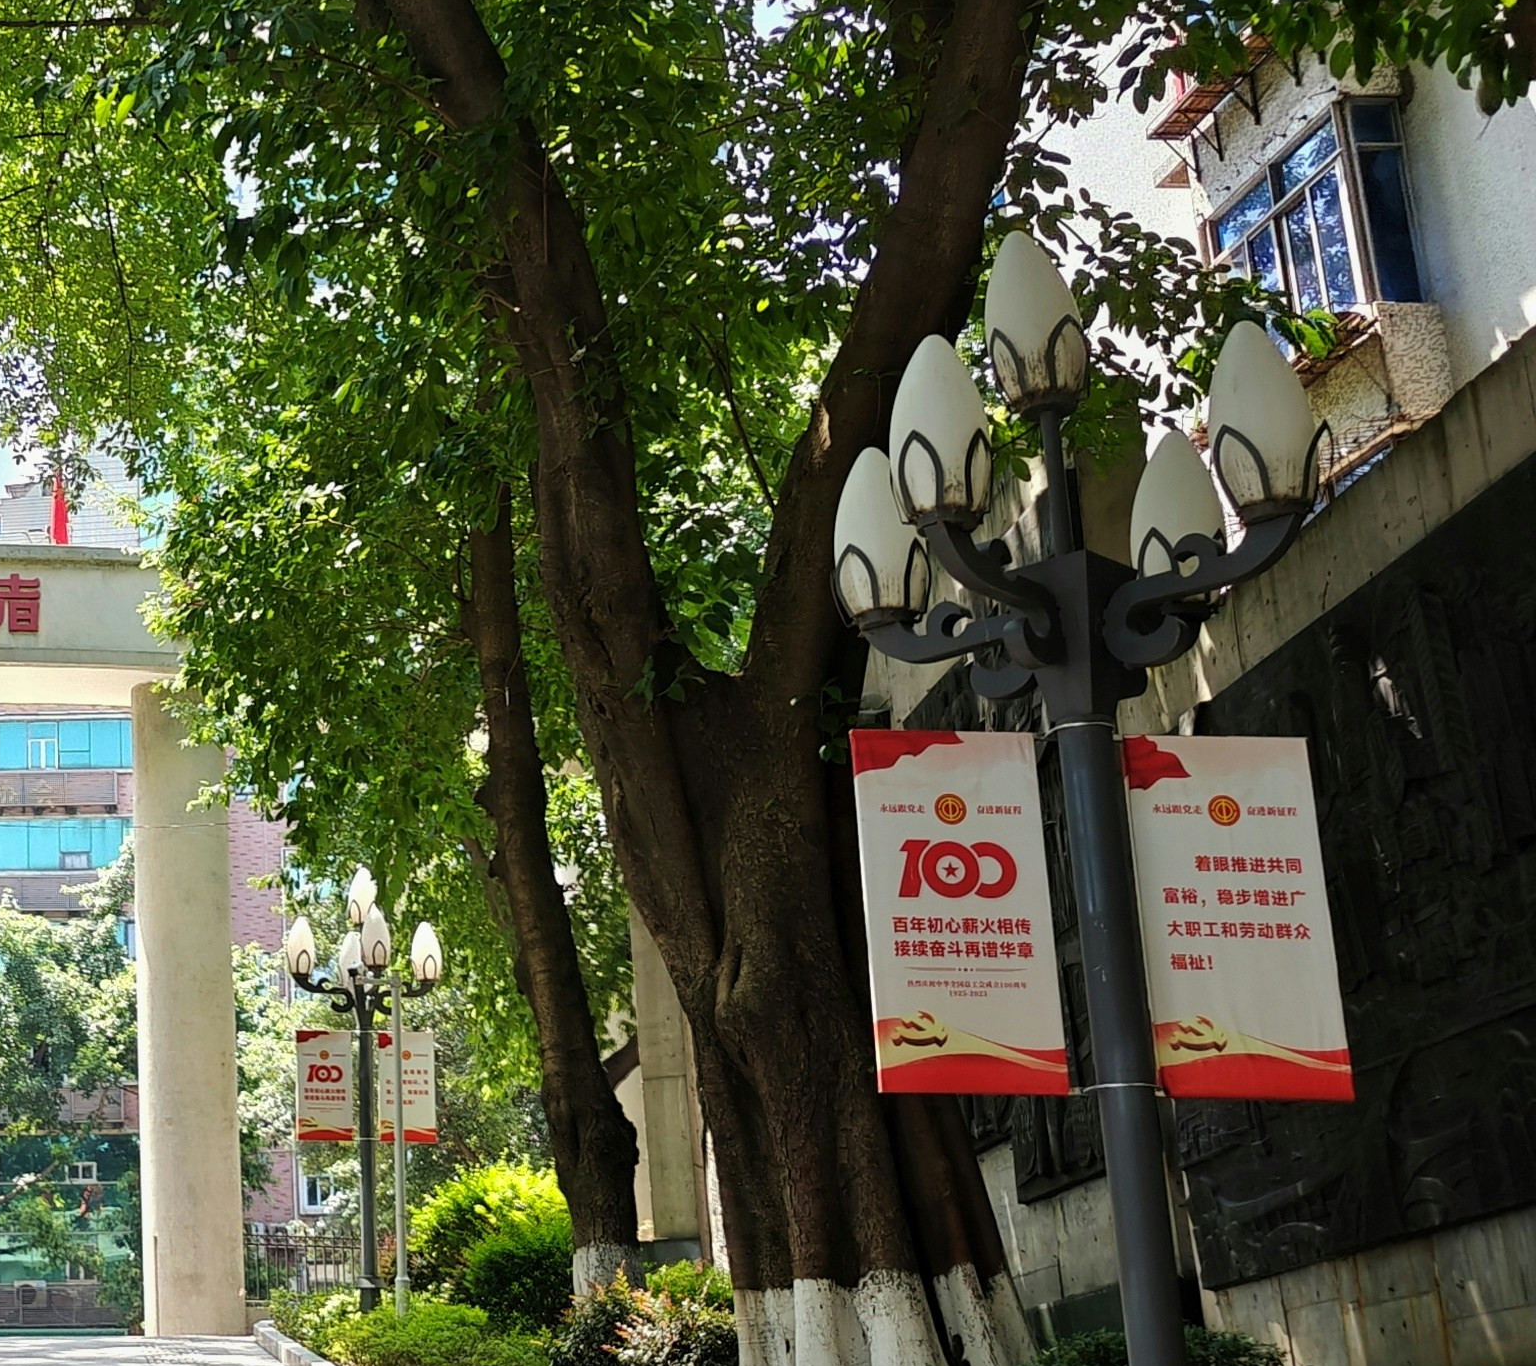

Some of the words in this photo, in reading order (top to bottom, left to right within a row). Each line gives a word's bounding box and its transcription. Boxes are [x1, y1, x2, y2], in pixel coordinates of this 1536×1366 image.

[879, 803, 925, 815] 永远跟党走
[977, 805, 1022, 815] 奋进新征程
[1152, 804, 1203, 815] 永远跟党走
[1247, 806, 1298, 817] 奋进新征程
[898, 838, 1018, 899] 100
[1194, 855, 1303, 874] 着眼推进共同
[1162, 887, 1306, 907] 富裕，稳步增进广
[892, 916, 1032, 935] 百年初心薪火相传
[1167, 920, 1312, 940] 大职工和劳动群众
[894, 940, 1035, 958] 接续奋斗再谱华章
[1170, 953, 1214, 971] 福祉！
